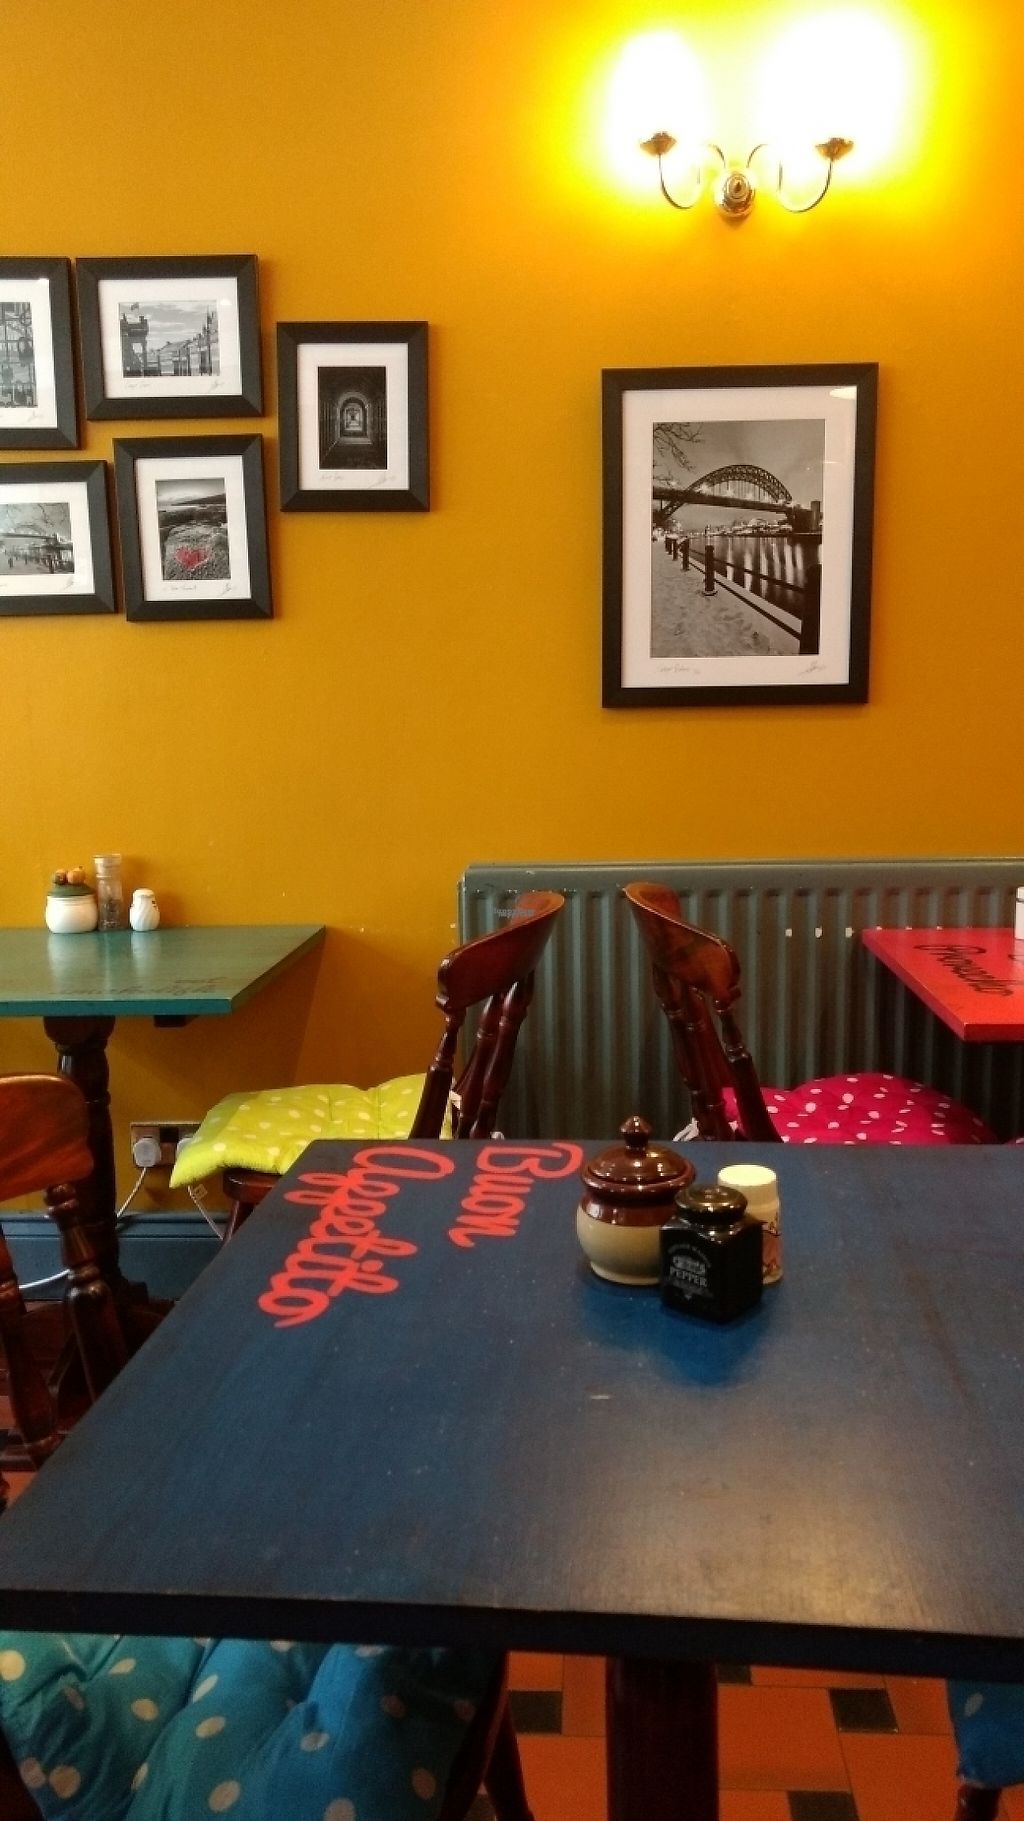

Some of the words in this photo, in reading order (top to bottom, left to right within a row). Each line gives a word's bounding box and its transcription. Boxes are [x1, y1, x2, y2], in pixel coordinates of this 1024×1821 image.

[257, 1145, 455, 1329] Appetito
[448, 1142, 583, 1248] Buon
[669, 1266, 708, 1288] PEPPER
